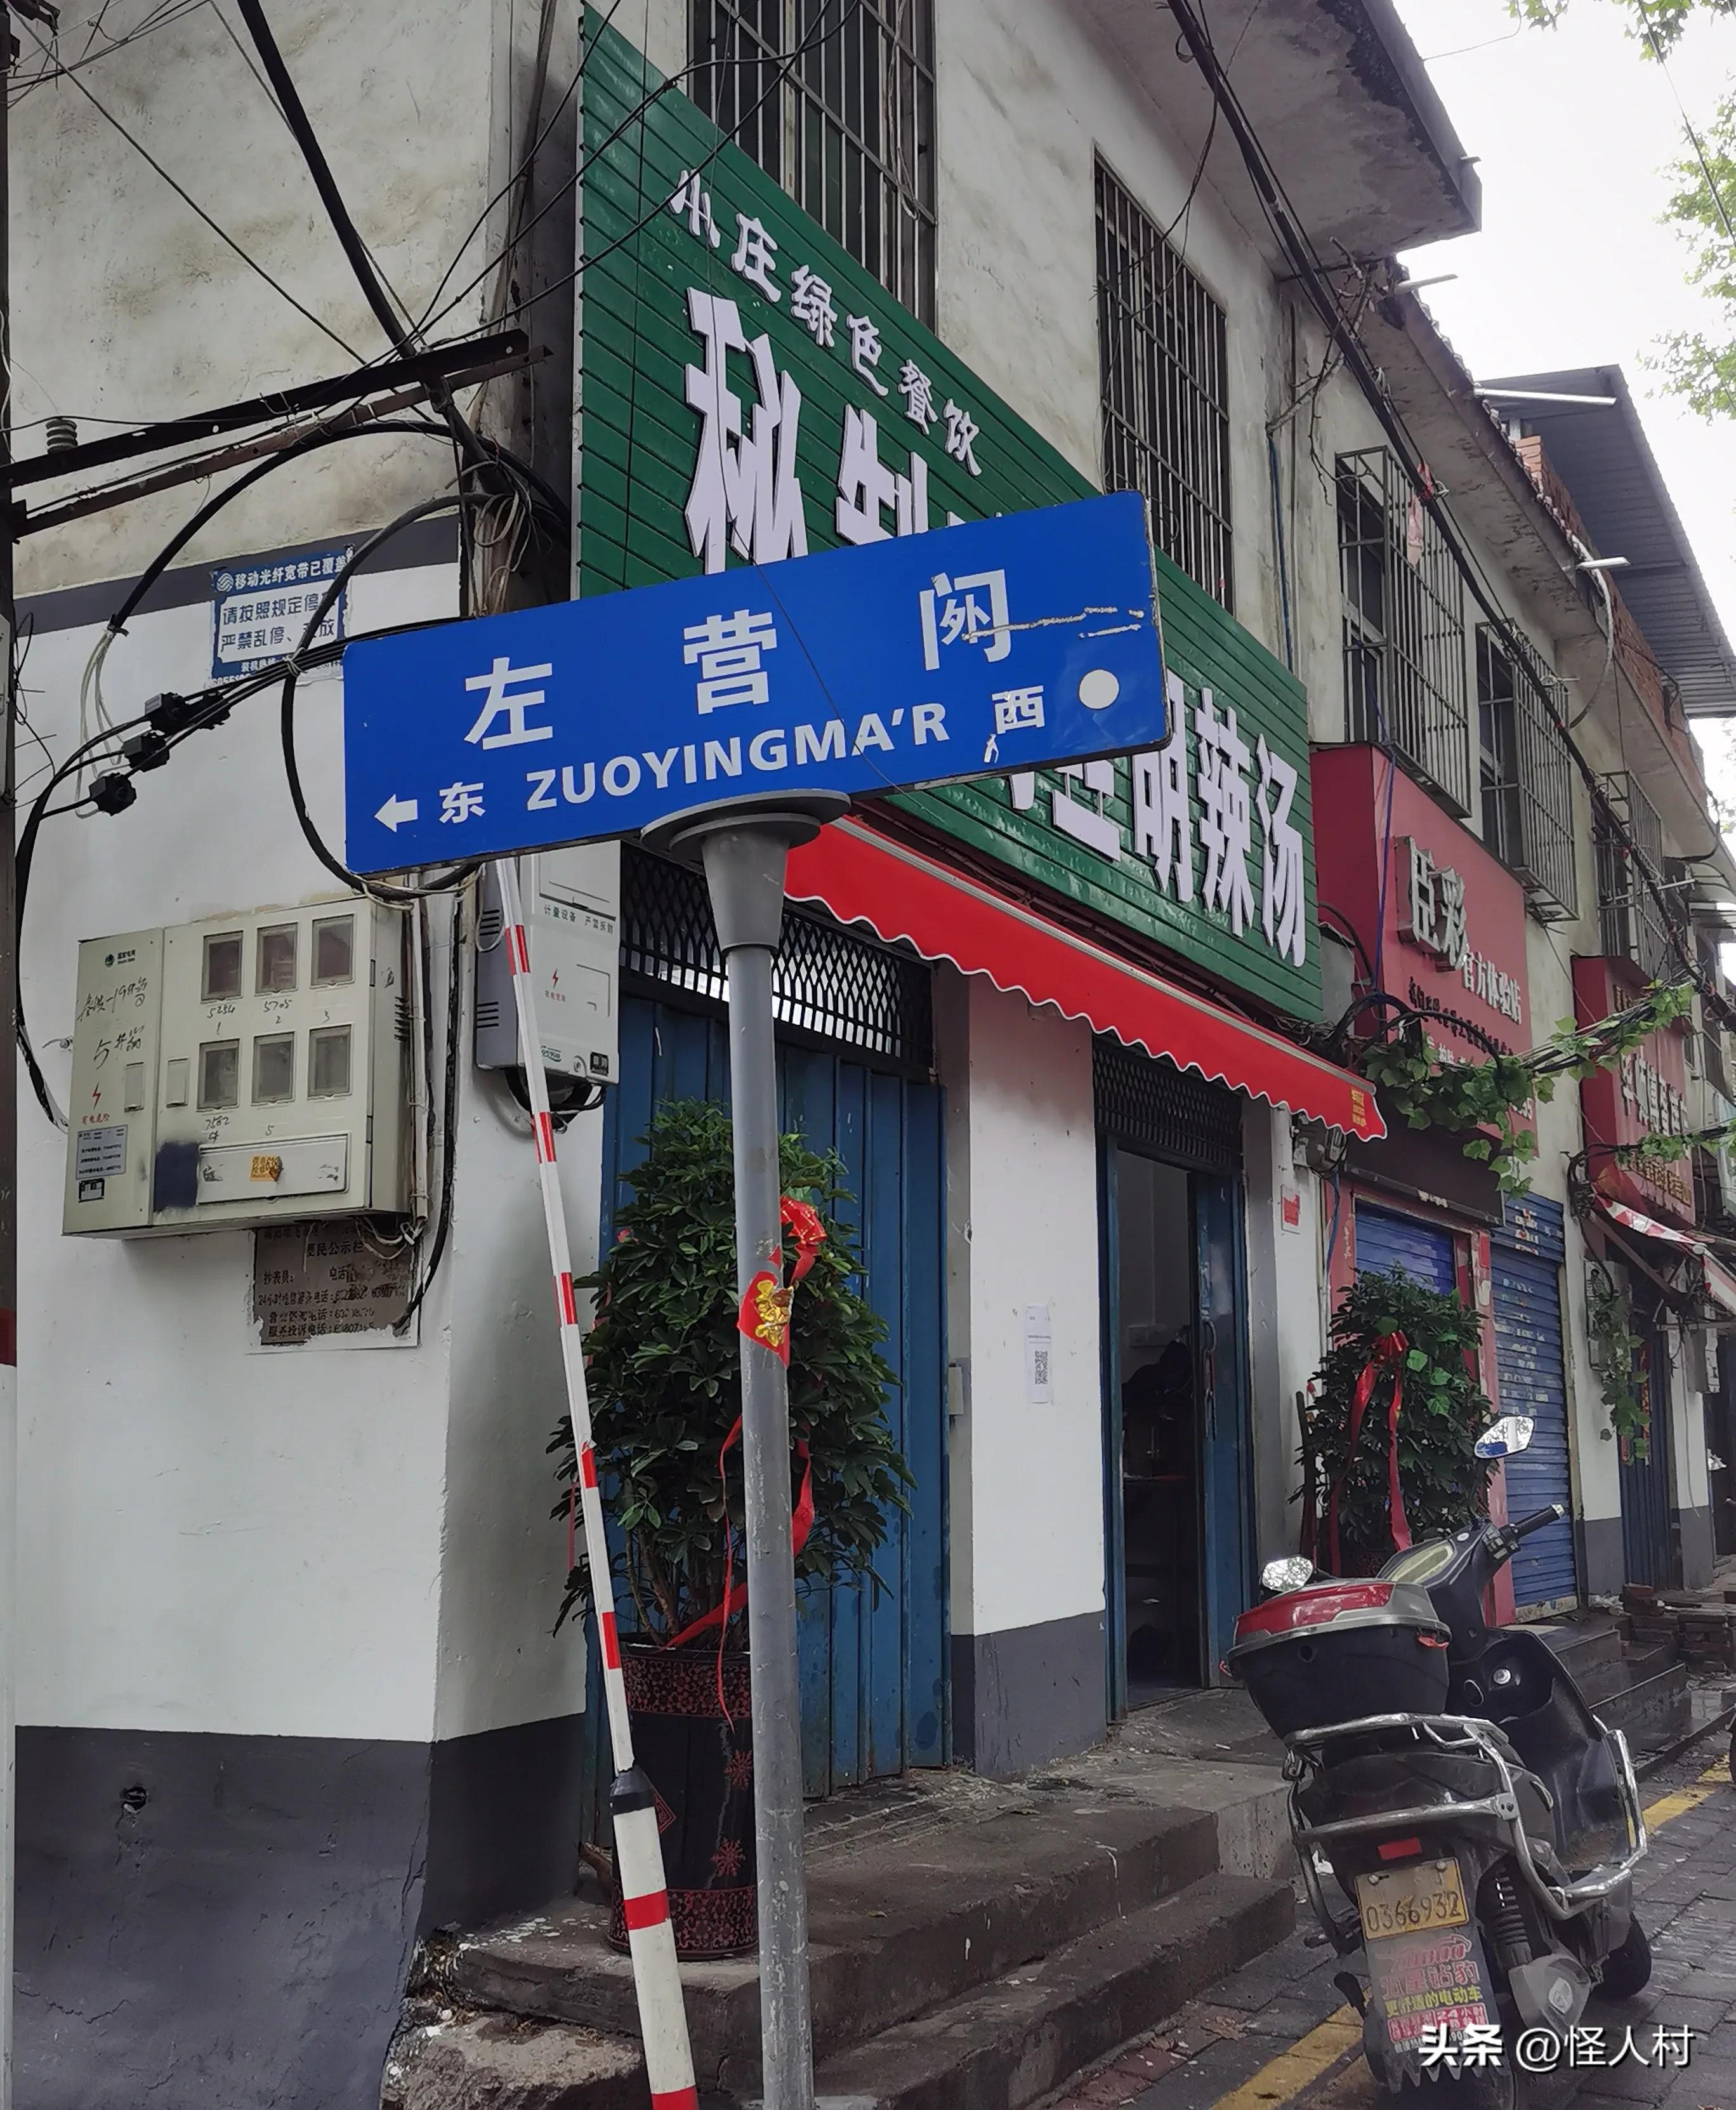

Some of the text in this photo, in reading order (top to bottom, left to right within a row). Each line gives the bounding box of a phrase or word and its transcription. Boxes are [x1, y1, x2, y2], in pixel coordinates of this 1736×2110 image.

[223, 592, 329, 626] 请按照规定停
[220, 618, 334, 652] 严禁乱停、放
[439, 685, 1046, 824] 东 ZUOYINGMA'R 西
